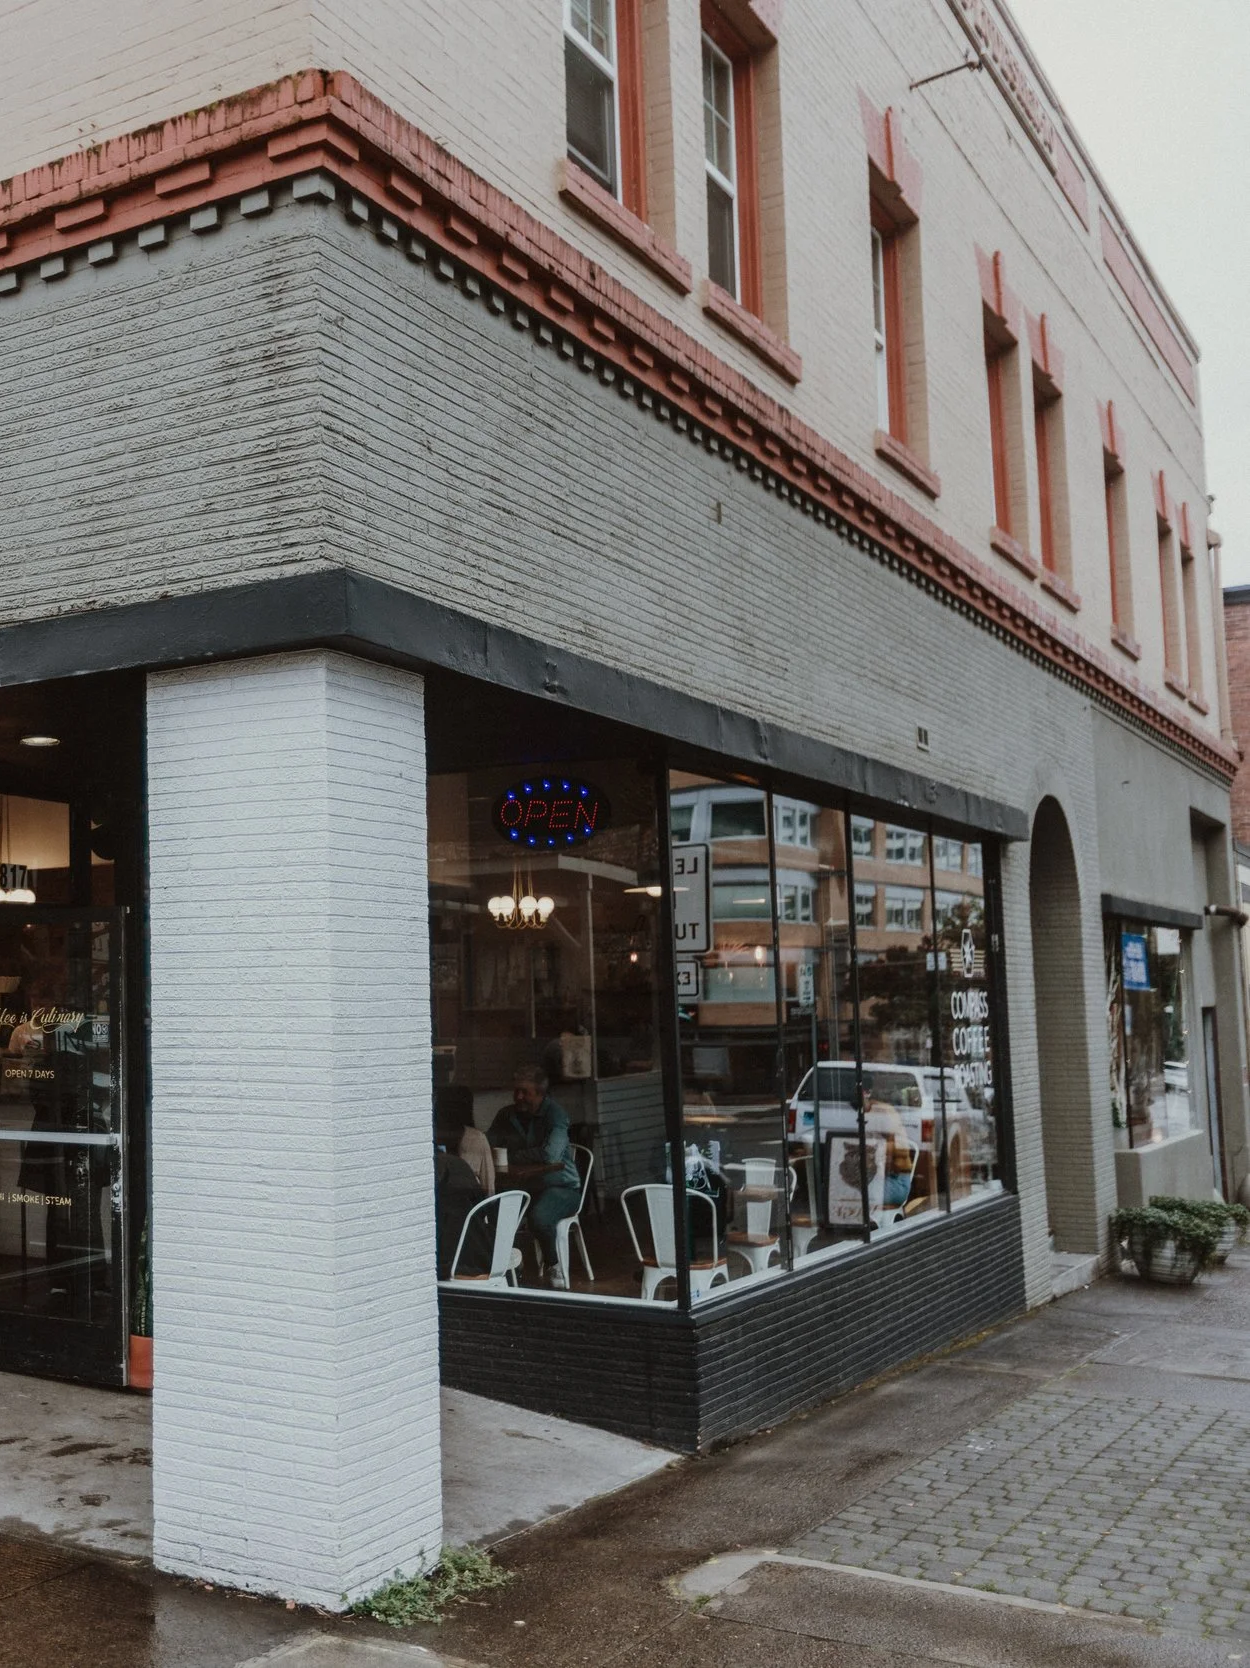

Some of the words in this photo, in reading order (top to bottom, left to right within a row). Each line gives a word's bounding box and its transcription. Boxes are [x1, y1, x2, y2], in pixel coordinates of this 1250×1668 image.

[500, 799, 598, 829] OPEN
[0, 863, 27, 888] 817
[19, 1011, 28, 1024] is
[30, 1006, 85, 1034] Culinary
[5, 1069, 27, 1078] OPEN
[28, 1069, 33, 1078] 7
[34, 1070, 55, 1079] DAYS
[12, 1193, 40, 1204] SMOKE
[45, 1196, 72, 1206] STEAM
